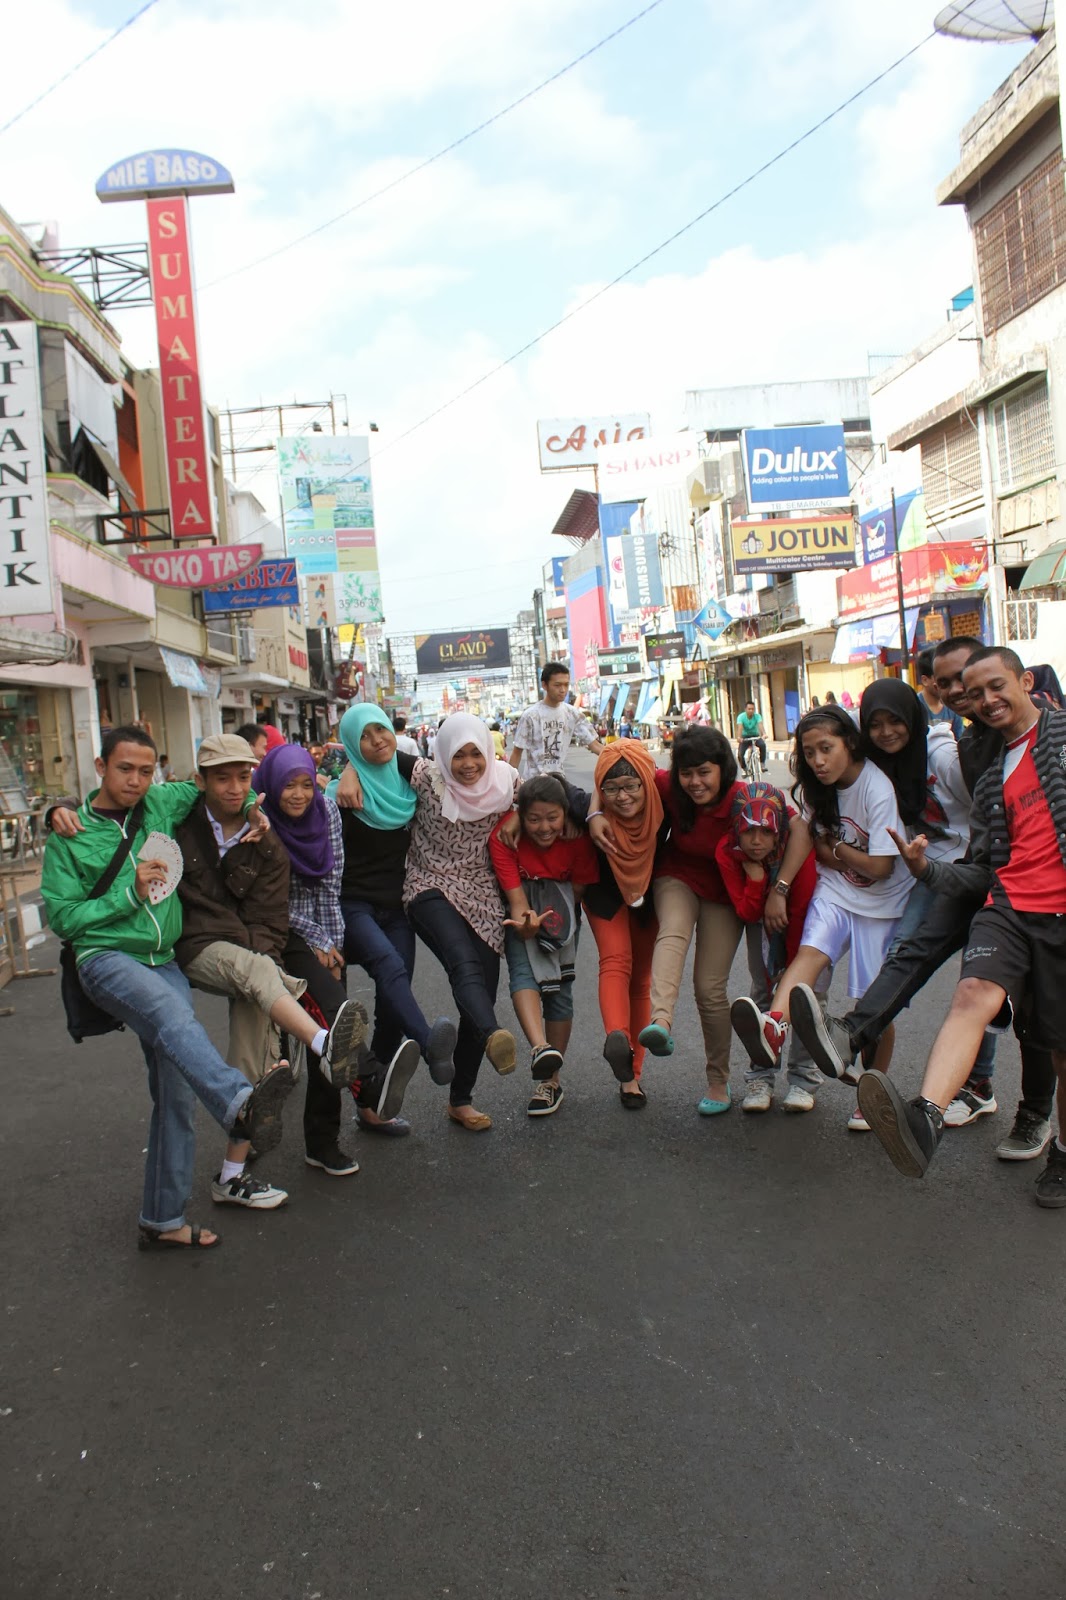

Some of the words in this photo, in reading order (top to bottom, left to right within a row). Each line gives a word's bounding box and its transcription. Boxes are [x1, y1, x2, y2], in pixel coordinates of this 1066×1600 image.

[107, 158, 149, 187] MIE
[153, 154, 218, 183] BASO
[157, 211, 206, 526] SUMATERA
[0, 327, 42, 588] ATLANTIK
[606, 450, 692, 475] SHARP
[752, 446, 838, 475] Dulux
[752, 477, 773, 485] Adding
[774, 475, 792, 483] colour
[800, 474, 824, 482] people's
[786, 500, 832, 510] SEMARANG
[767, 526, 848, 552] JOTUN
[139, 554, 203, 583] TOKO
[208, 549, 252, 579] TAS
[633, 537, 651, 605] SAMSUNG
[766, 556, 801, 564] Multicolor
[209, 562, 298, 592] BEZ
[339, 599, 351, 609] 35
[354, 598, 366, 608] 36
[368, 597, 380, 607] 37
[439, 641, 487, 657] CLAVO
